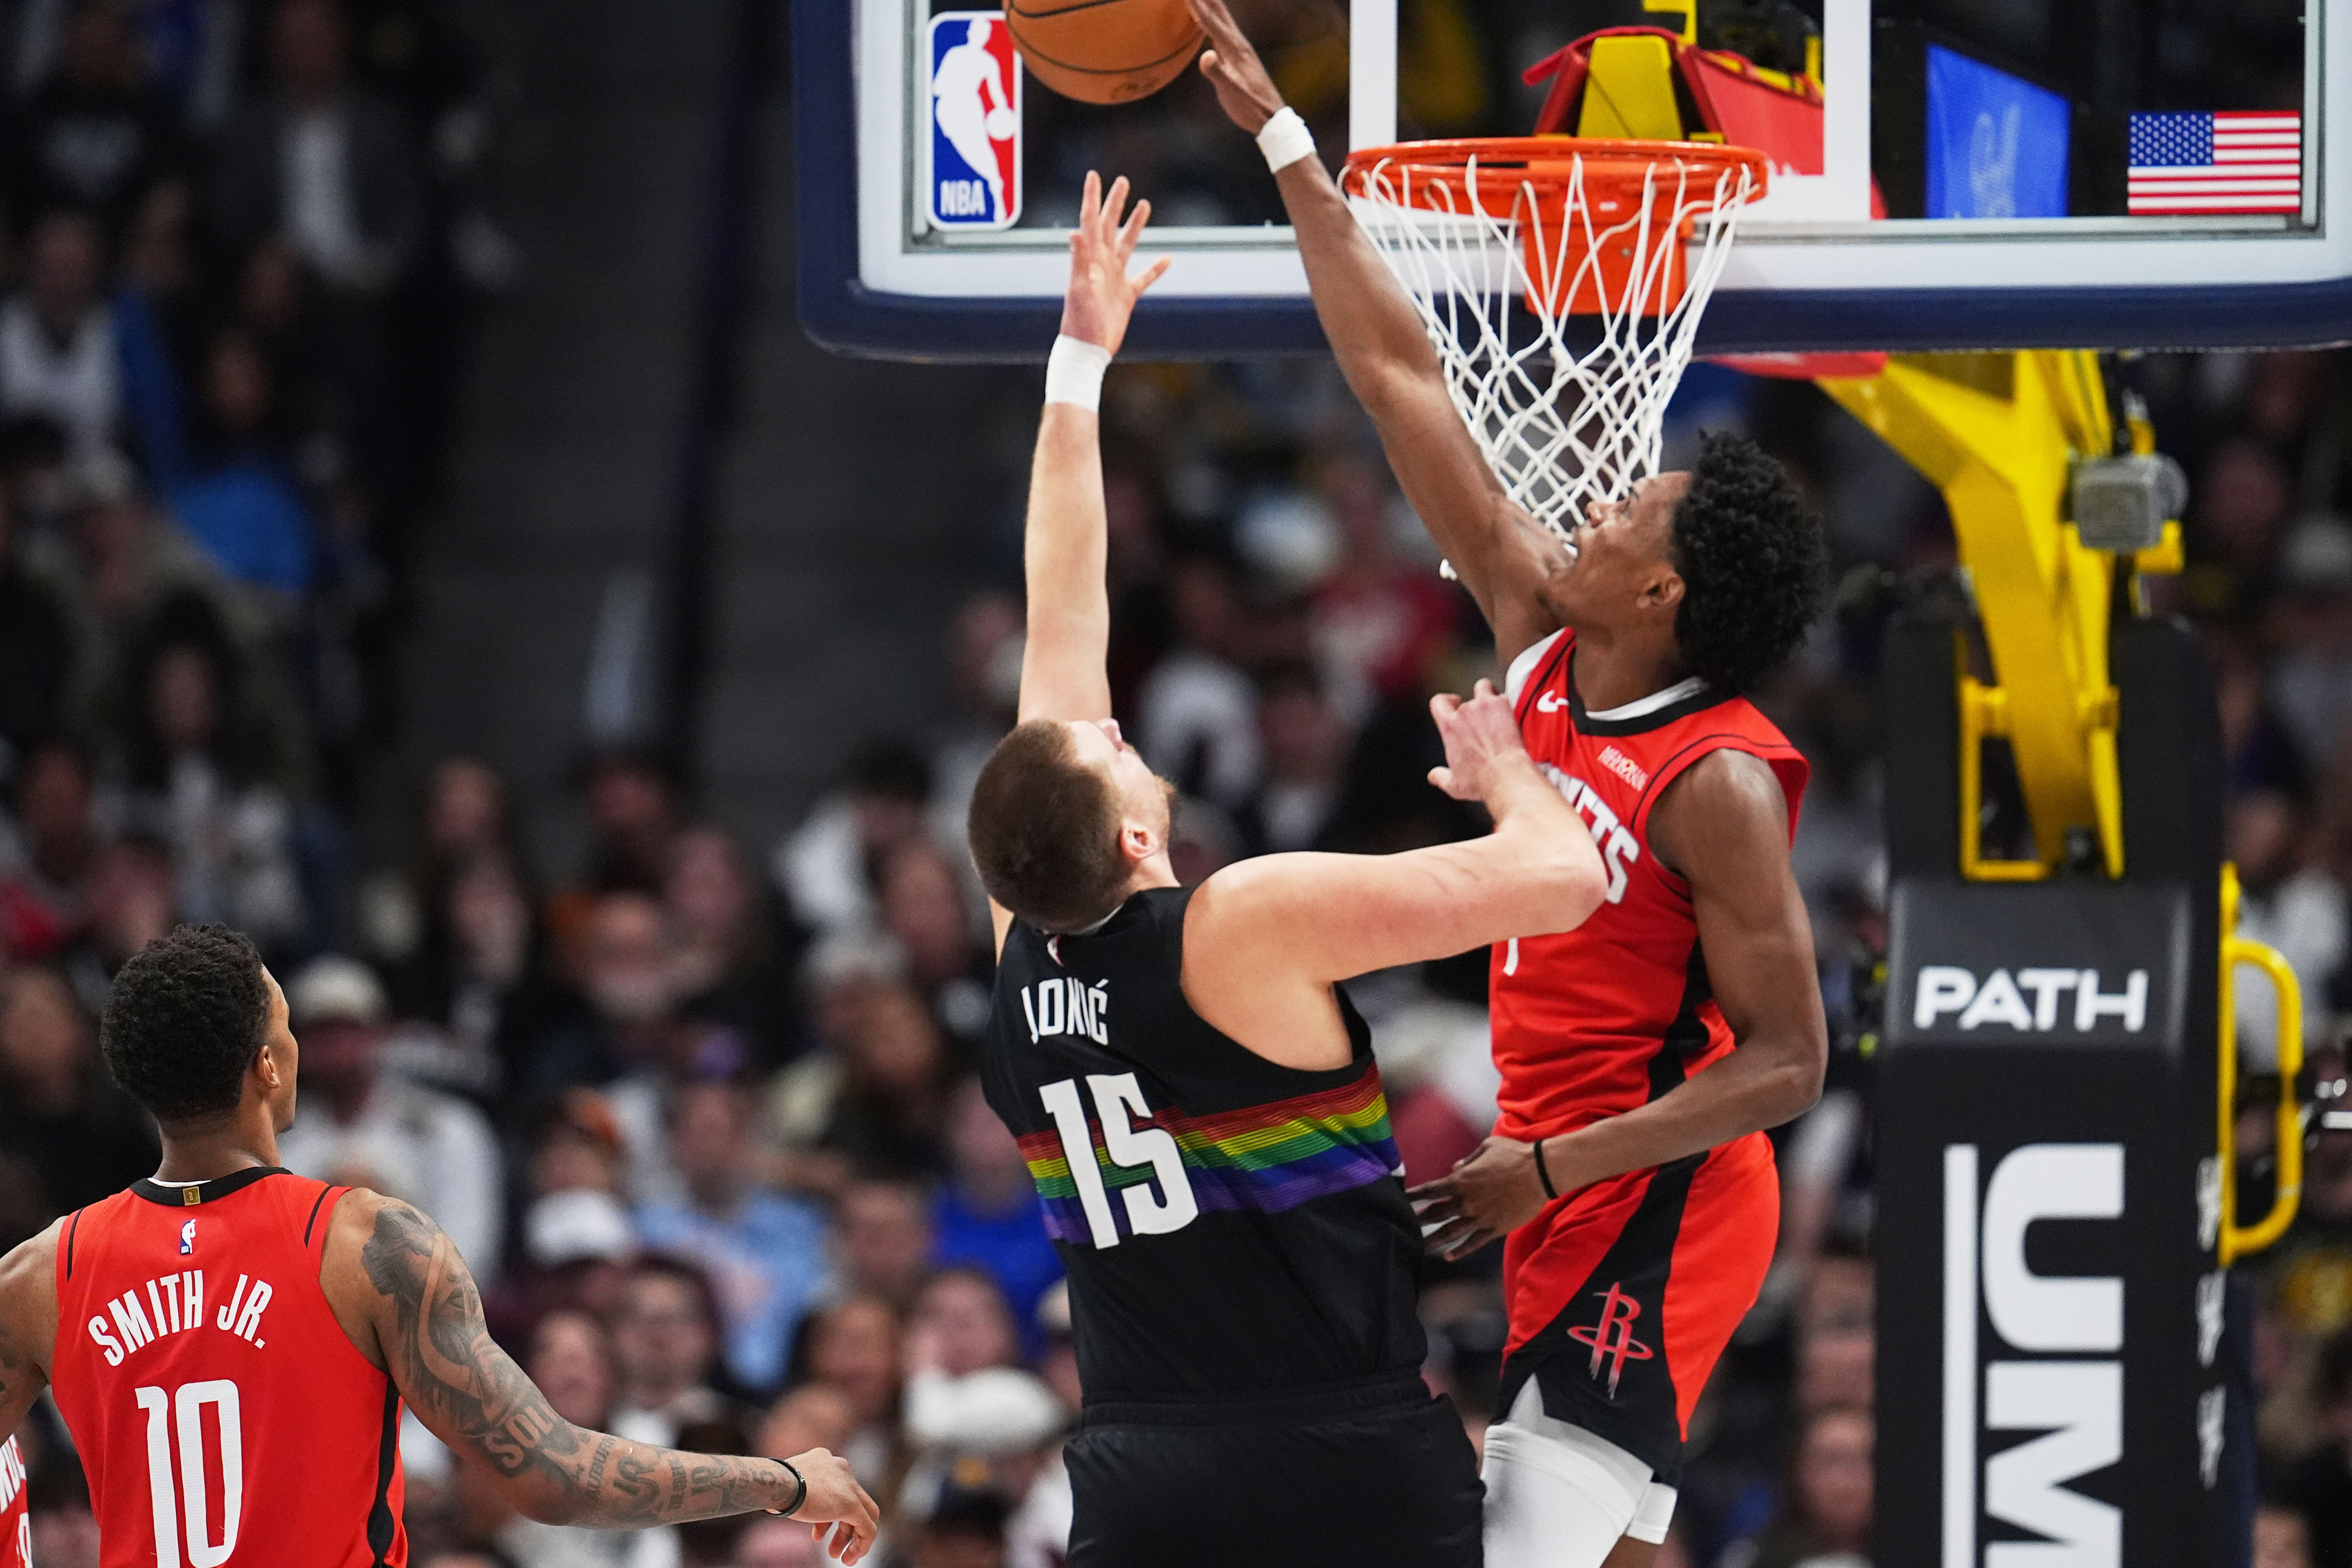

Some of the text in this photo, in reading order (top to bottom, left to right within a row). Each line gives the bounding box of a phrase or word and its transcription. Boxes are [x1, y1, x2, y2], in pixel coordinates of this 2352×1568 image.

[940, 180, 986, 216] NBA
[1021, 977, 1109, 1046] JOKIĆ
[1914, 965, 2149, 1032] PATH
[1038, 1072, 1199, 1250] 15
[88, 1269, 273, 1367] SMITH JR.
[135, 1379, 243, 1568] 10
